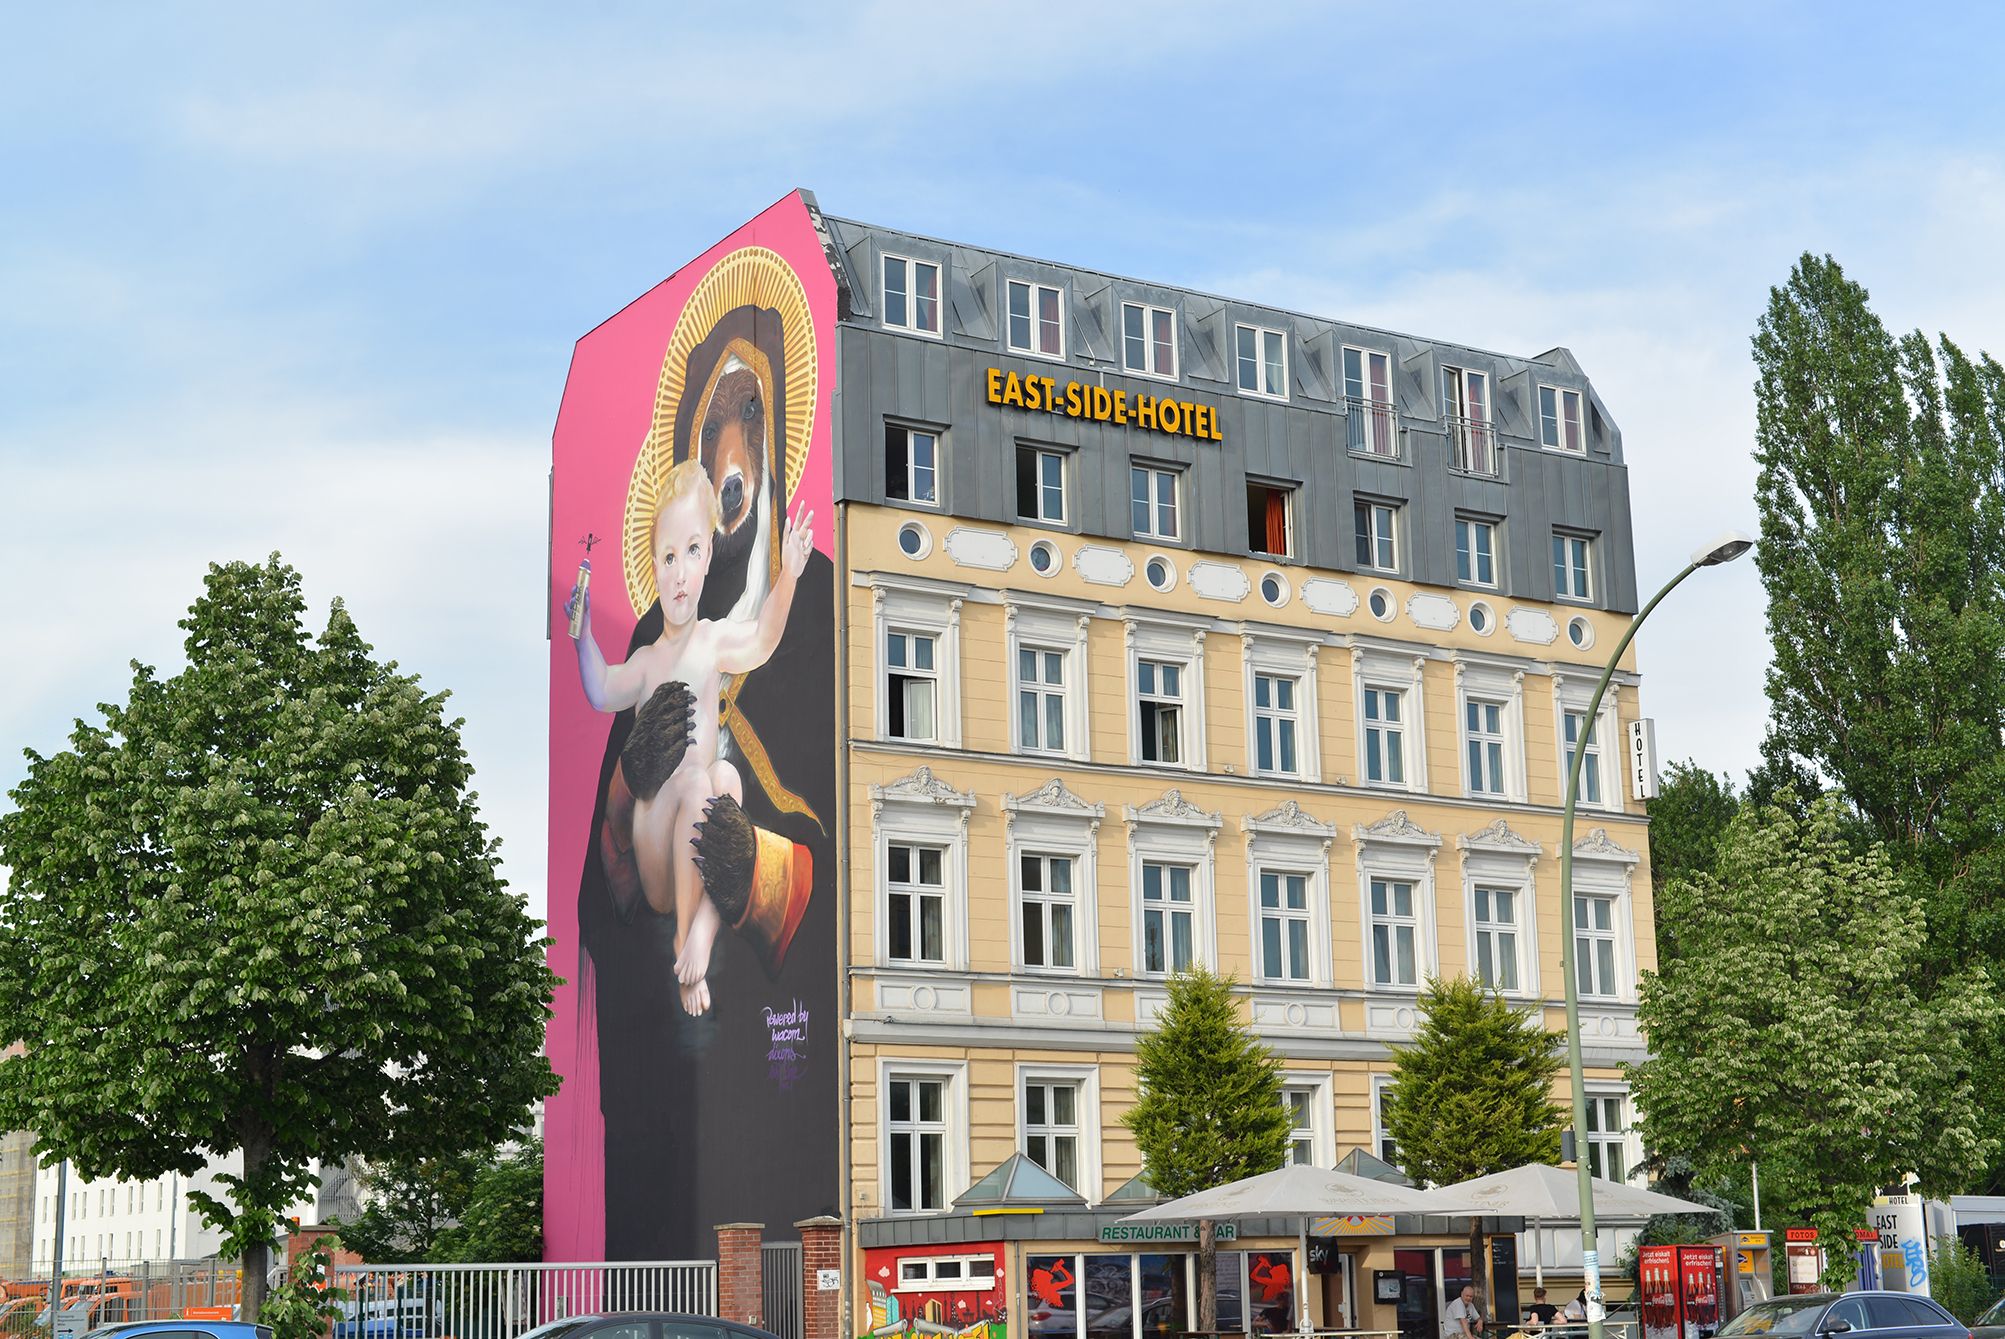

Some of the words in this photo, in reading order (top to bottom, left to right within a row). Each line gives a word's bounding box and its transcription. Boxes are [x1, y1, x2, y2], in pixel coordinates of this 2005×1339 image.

[986, 367, 1223, 442] EAST-SIDE-HOTEL
[1634, 722, 1645, 798] HOTEL
[1888, 1196, 1909, 1205] HOTEL
[1876, 1214, 1898, 1230] EAST
[1102, 1226, 1190, 1240] RESTAURANT
[1790, 1231, 1815, 1239] FOTOS
[1880, 1234, 1899, 1249] SIDE
[1309, 1245, 1329, 1265] sky
